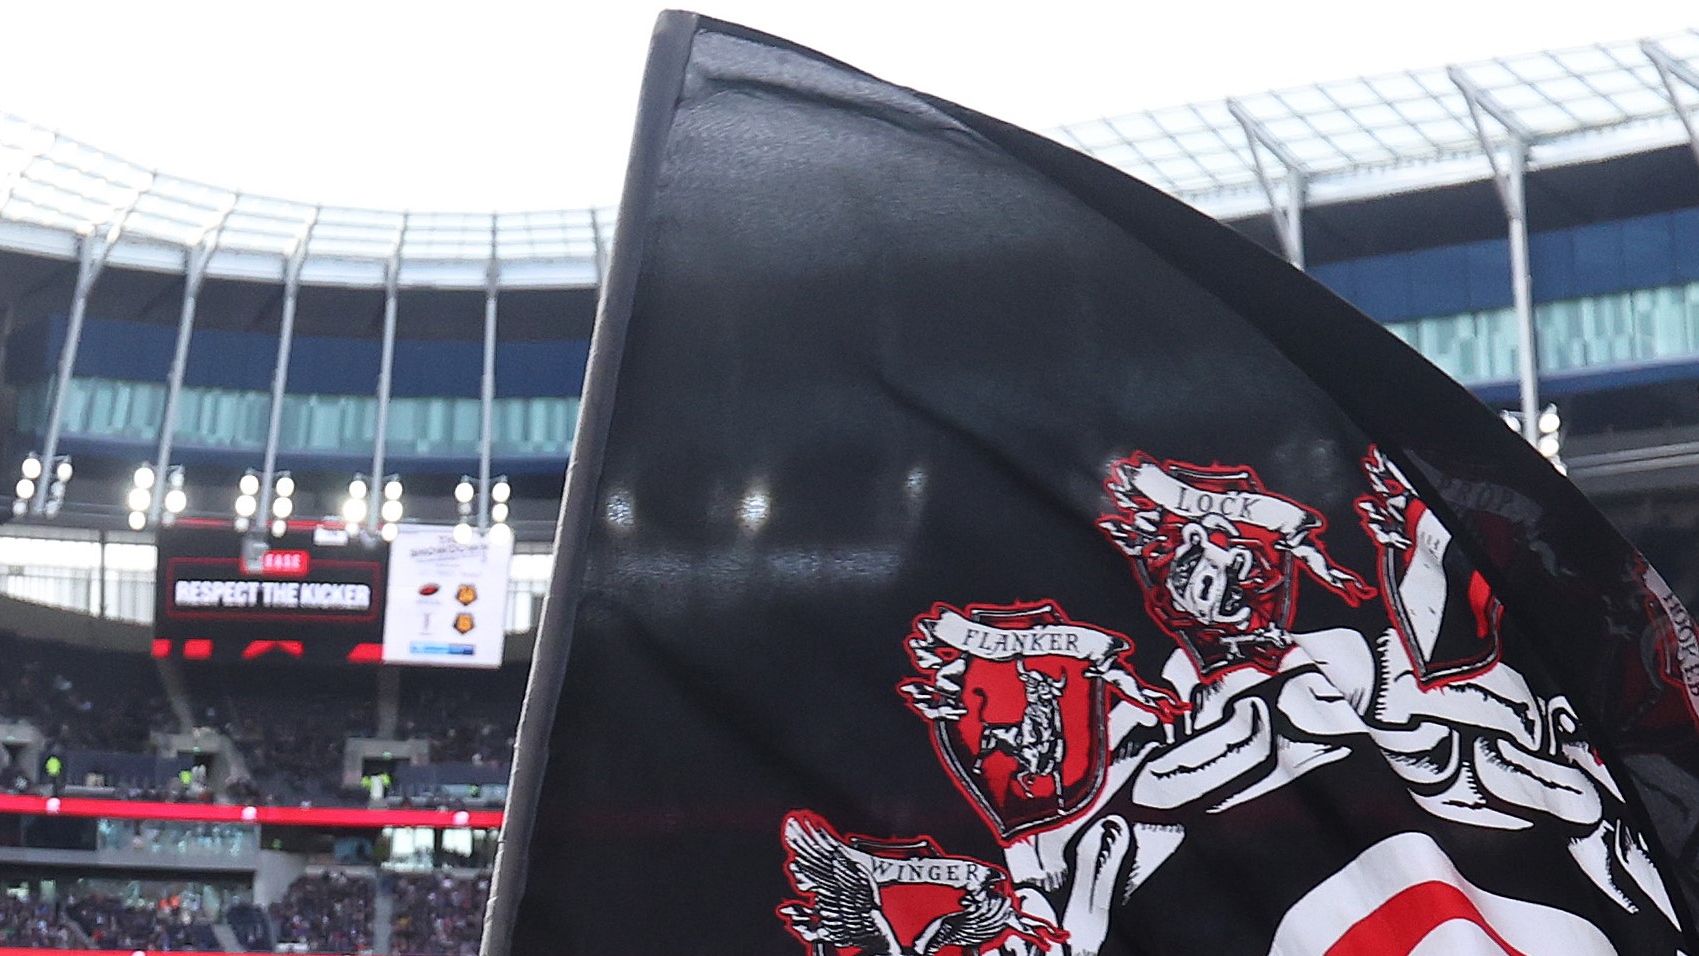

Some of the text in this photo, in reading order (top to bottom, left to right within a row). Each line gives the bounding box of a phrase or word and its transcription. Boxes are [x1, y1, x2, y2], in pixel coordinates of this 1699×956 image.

[1175, 485, 1261, 519] LOCK
[174, 580, 371, 611] RESPECT THE KICKER
[962, 628, 1080, 653] FLANKER
[870, 857, 979, 881] WINGER
